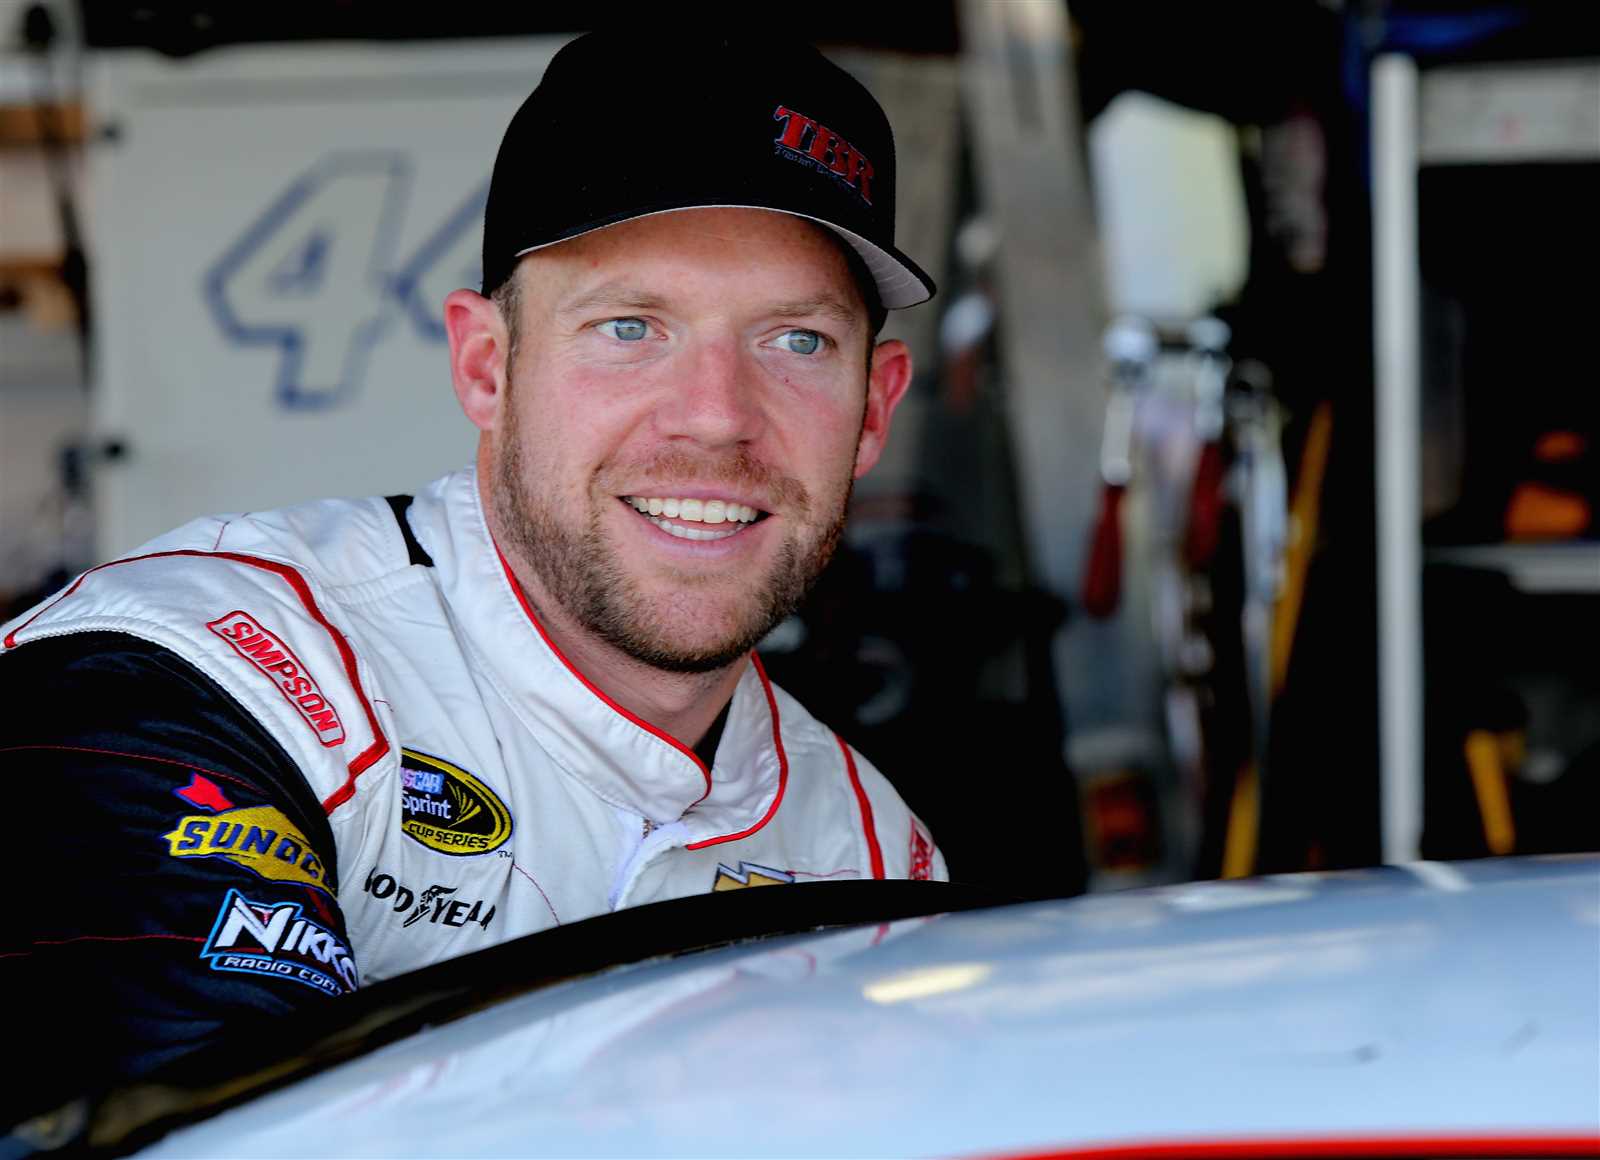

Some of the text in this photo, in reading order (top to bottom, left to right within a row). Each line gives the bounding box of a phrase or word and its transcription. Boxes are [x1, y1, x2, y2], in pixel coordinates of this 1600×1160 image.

[774, 105, 875, 206] TBR
[222, 621, 339, 732] SIMPSON
[400, 767, 443, 794] SCAR
[401, 790, 452, 819] Sprint
[176, 820, 333, 886] SUNOC
[408, 823, 492, 849] CUP SERIES
[214, 897, 358, 992] NIKKO
[223, 956, 293, 974] RADIO
